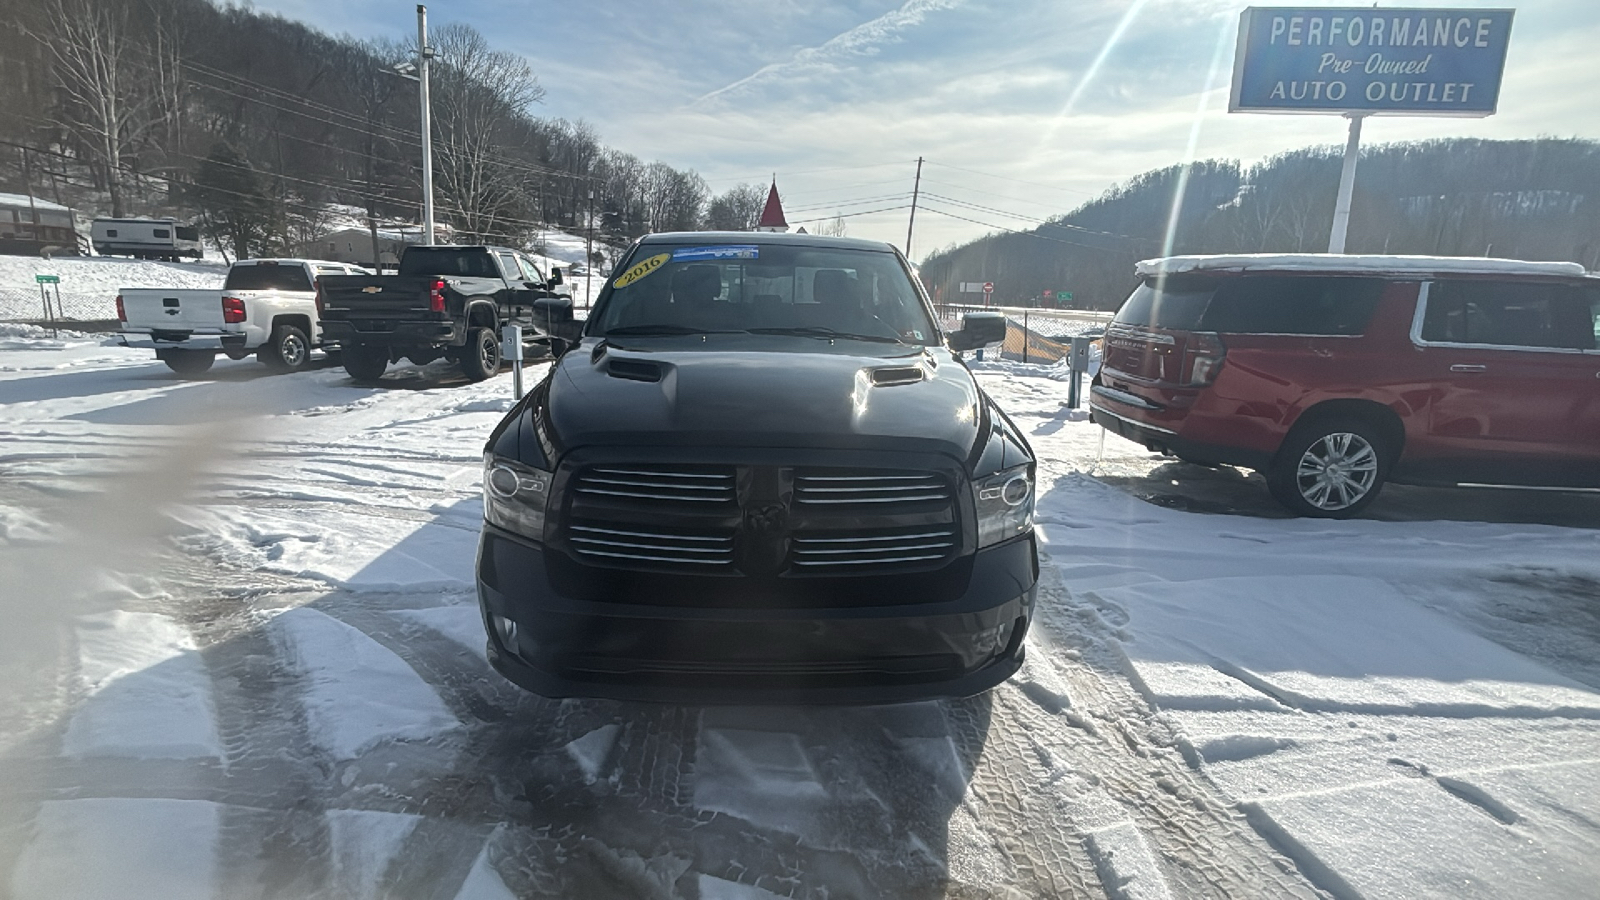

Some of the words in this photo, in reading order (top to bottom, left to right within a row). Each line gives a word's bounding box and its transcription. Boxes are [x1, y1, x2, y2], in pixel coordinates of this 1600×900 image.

[1270, 17, 1492, 48] PERFORMANCE
[1318, 53, 1432, 74] Pre-Owned
[1269, 81, 1347, 101] AUTO
[1365, 81, 1474, 102] OUTLET
[624, 258, 661, 283] 2016
